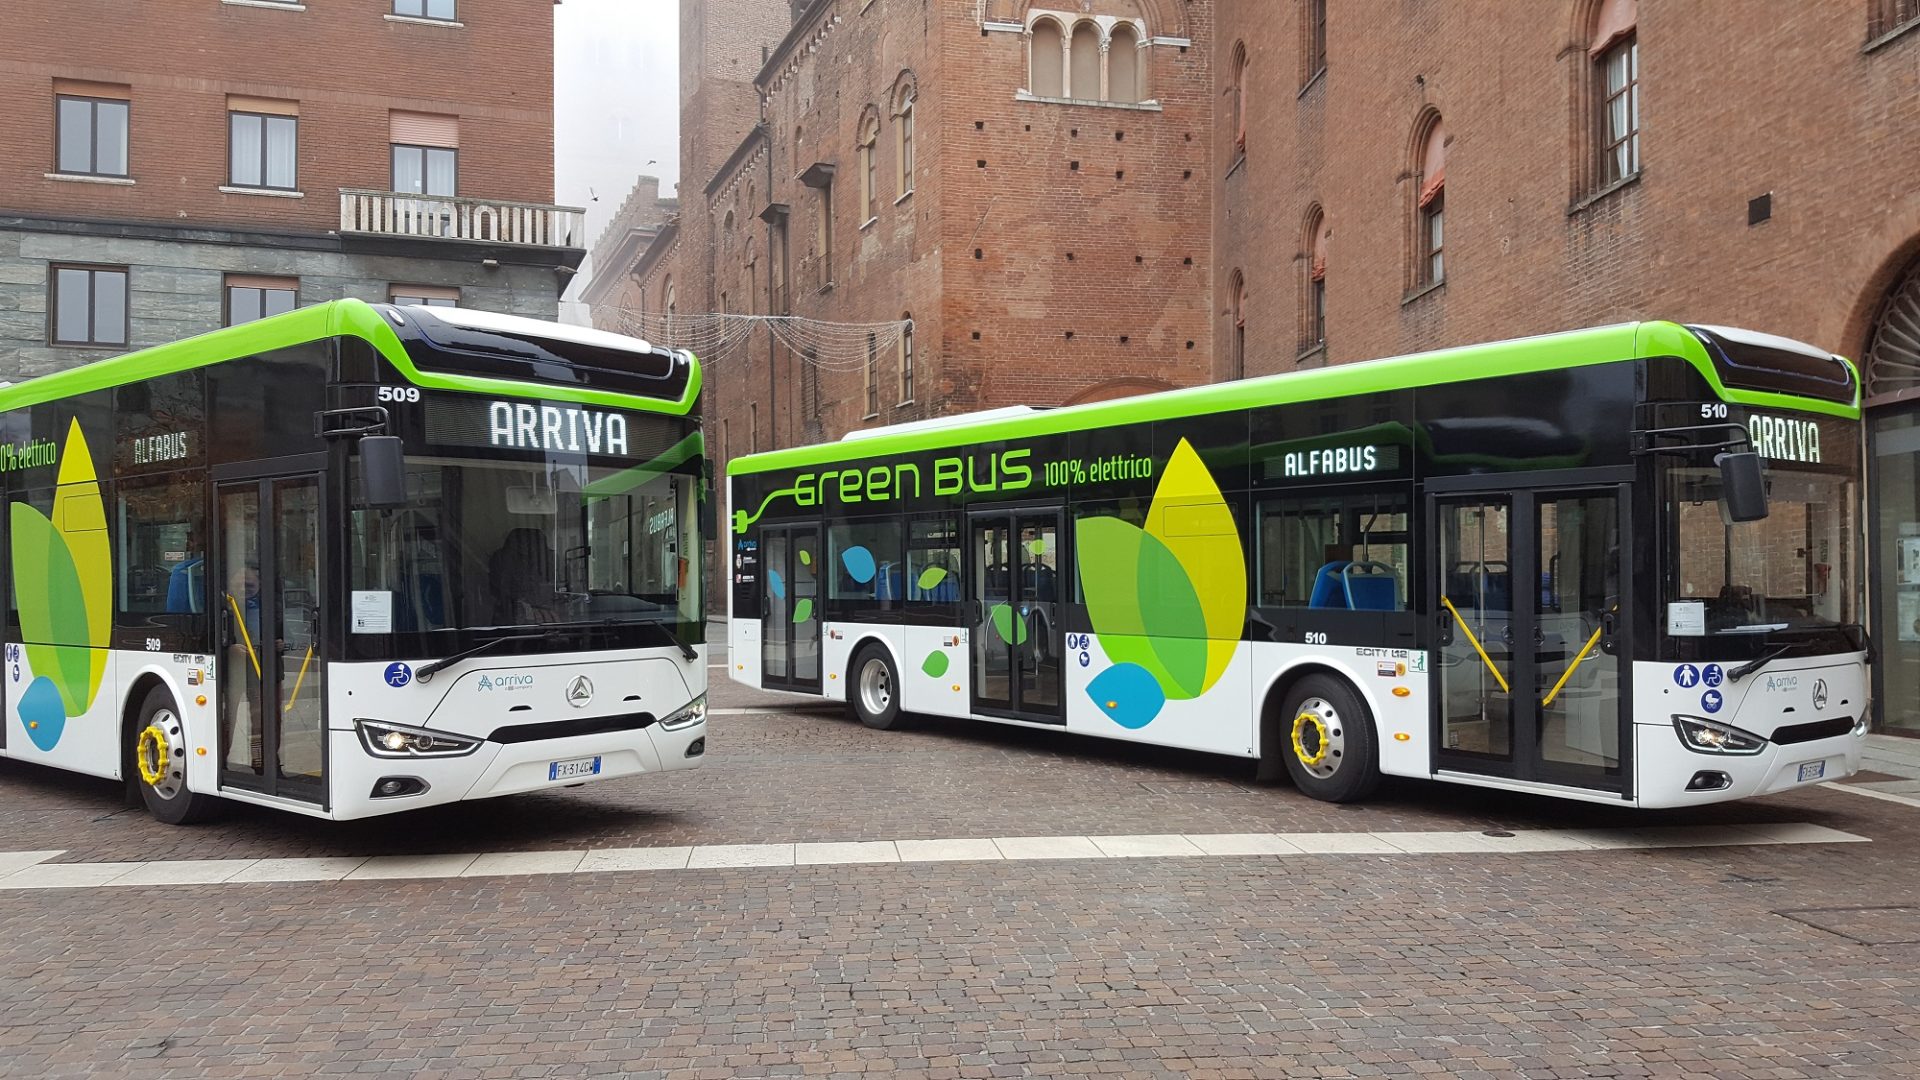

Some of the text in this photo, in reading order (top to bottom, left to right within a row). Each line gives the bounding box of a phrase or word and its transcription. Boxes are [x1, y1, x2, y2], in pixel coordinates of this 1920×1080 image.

[377, 386, 421, 403] 509
[1700, 403, 1728, 419] 510
[489, 401, 628, 456] ARRIVA
[1748, 414, 1821, 464] ARRIVA
[18, 437, 57, 470] elettrico
[134, 431, 188, 465] ALFABUS
[1284, 445, 1377, 477] ALFABUS
[934, 448, 1033, 497] BUS
[1043, 453, 1152, 487] 100% elettrico
[145, 637, 161, 651] 509
[1304, 631, 1327, 645] 510
[1355, 647, 1389, 658] ECITY
[494, 673, 534, 687] arriva
